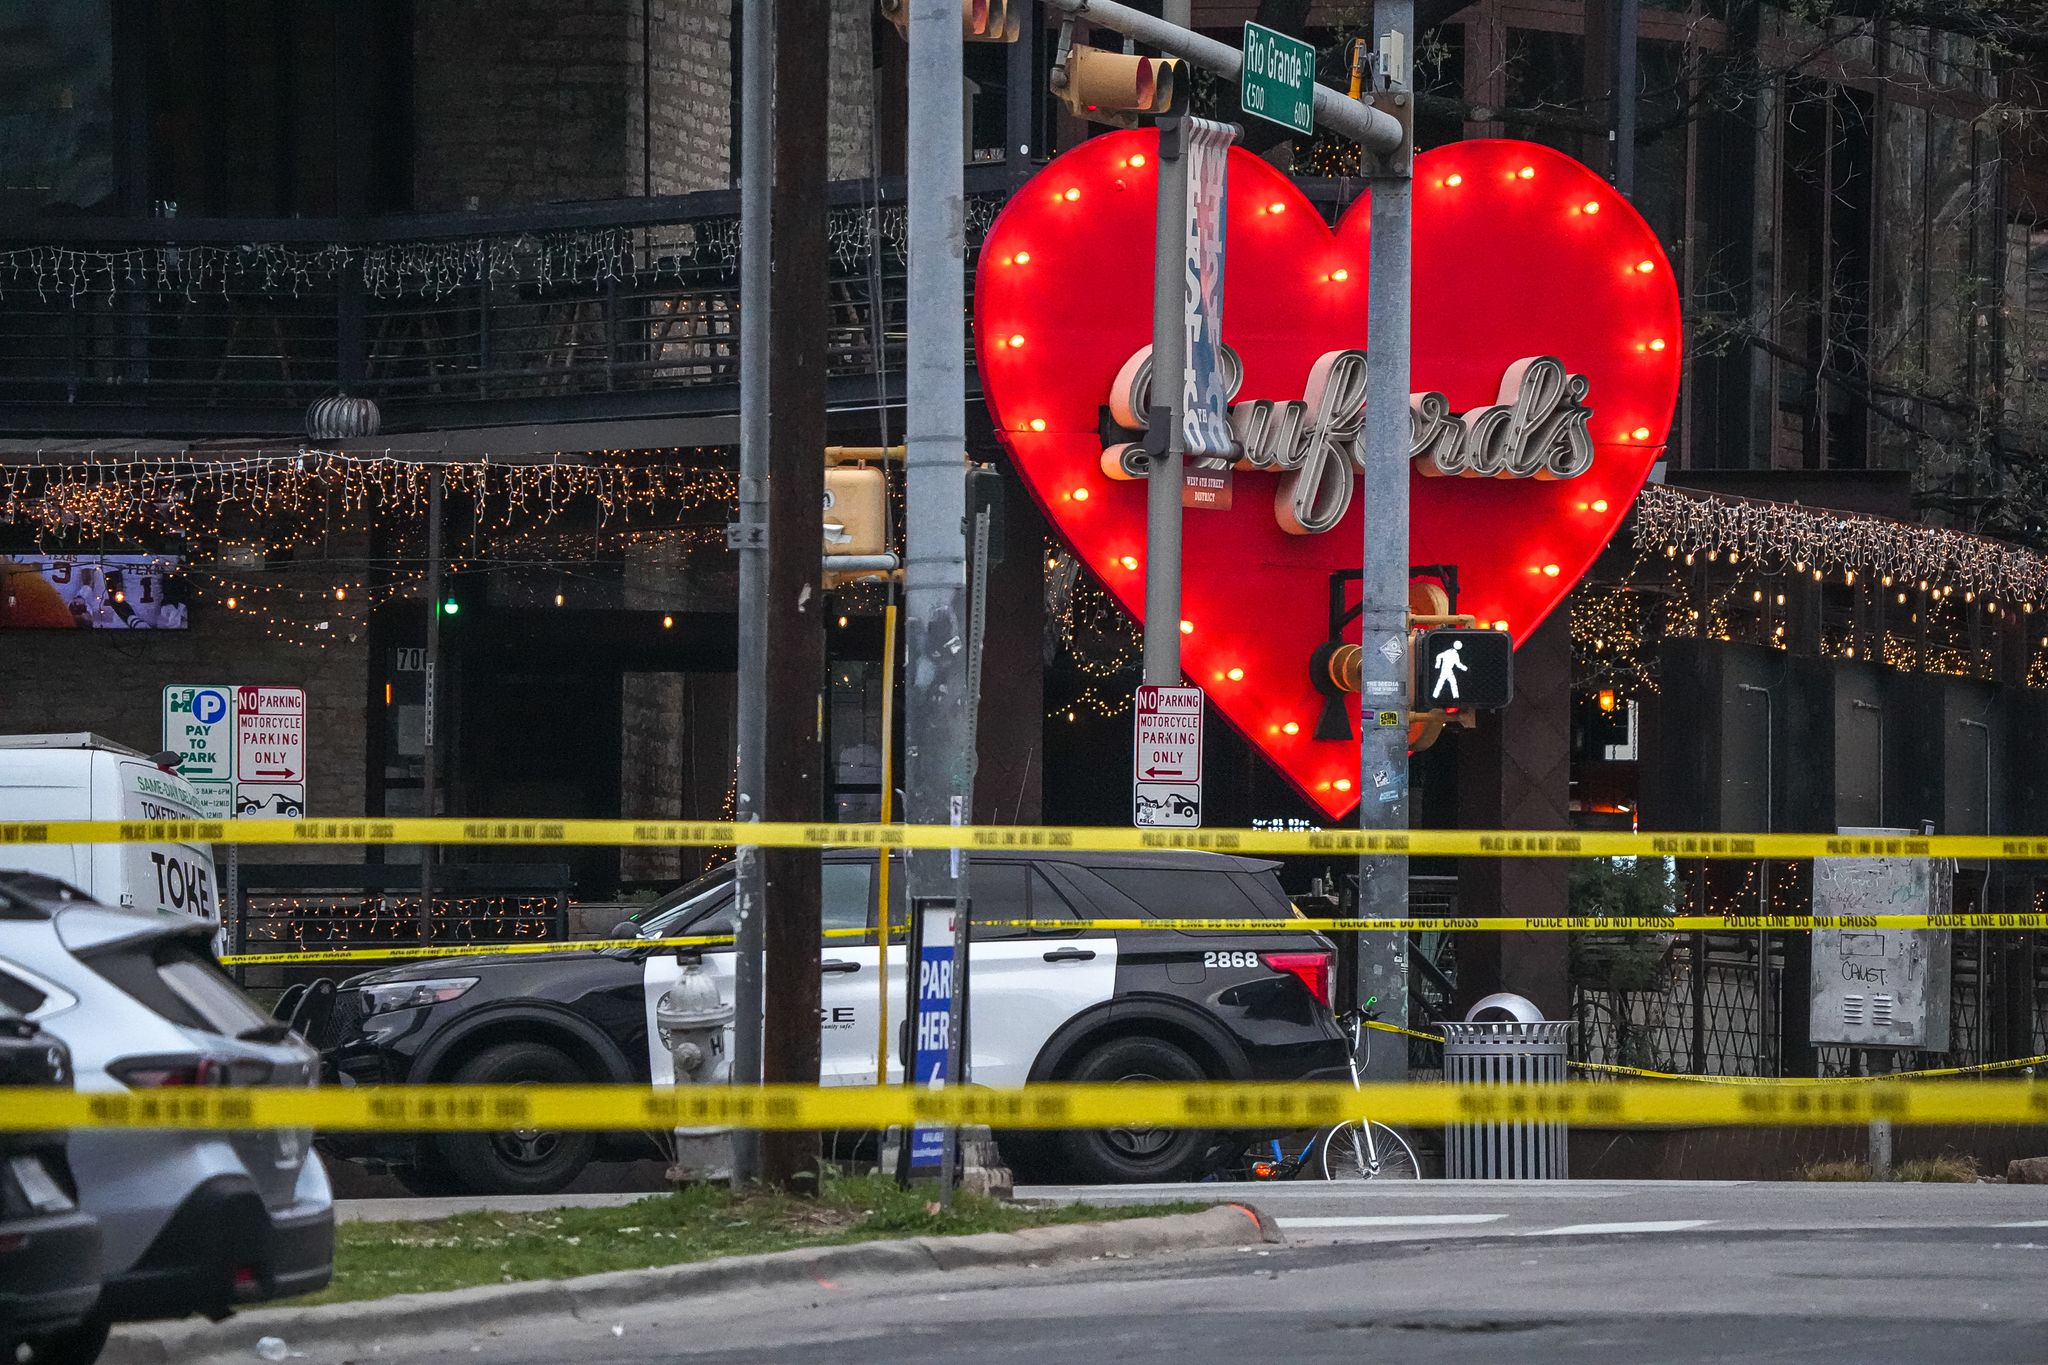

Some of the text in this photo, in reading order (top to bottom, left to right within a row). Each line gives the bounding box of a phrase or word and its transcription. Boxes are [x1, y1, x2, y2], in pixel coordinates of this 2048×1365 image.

[1247, 29, 1312, 89] Rio Grande ST
[1194, 491, 1216, 502] DISTRICT
[52, 562, 72, 584] 3
[140, 577, 154, 603] 1
[238, 692, 301, 711] NO PARKING
[1139, 691, 1199, 710] NO PARKING
[241, 716, 301, 729] MOTORCYCLE
[1140, 716, 1198, 728] MOTORCYCLE
[185, 725, 211, 736] PAY
[189, 738, 206, 749] TO
[244, 732, 298, 745] PARKING
[1142, 732, 1196, 745] PARKING
[180, 752, 217, 763] PARK
[255, 751, 287, 764] ONLY
[1153, 751, 1184, 764] ONLY
[200, 799, 230, 807] AM-12MID
[151, 851, 209, 920] TOKE
[1526, 917, 1675, 928] POLICE LINE DO NOT CROSS
[1724, 916, 1877, 927] POLICE LINE DO NOT CROSS
[1927, 915, 1966, 926] POLICE
[1970, 915, 1995, 926] LINE
[2000, 915, 2015, 926] DO
[2019, 915, 2041, 926] NOT
[1204, 951, 1259, 968] 2868
[918, 1011, 950, 1051] HER
